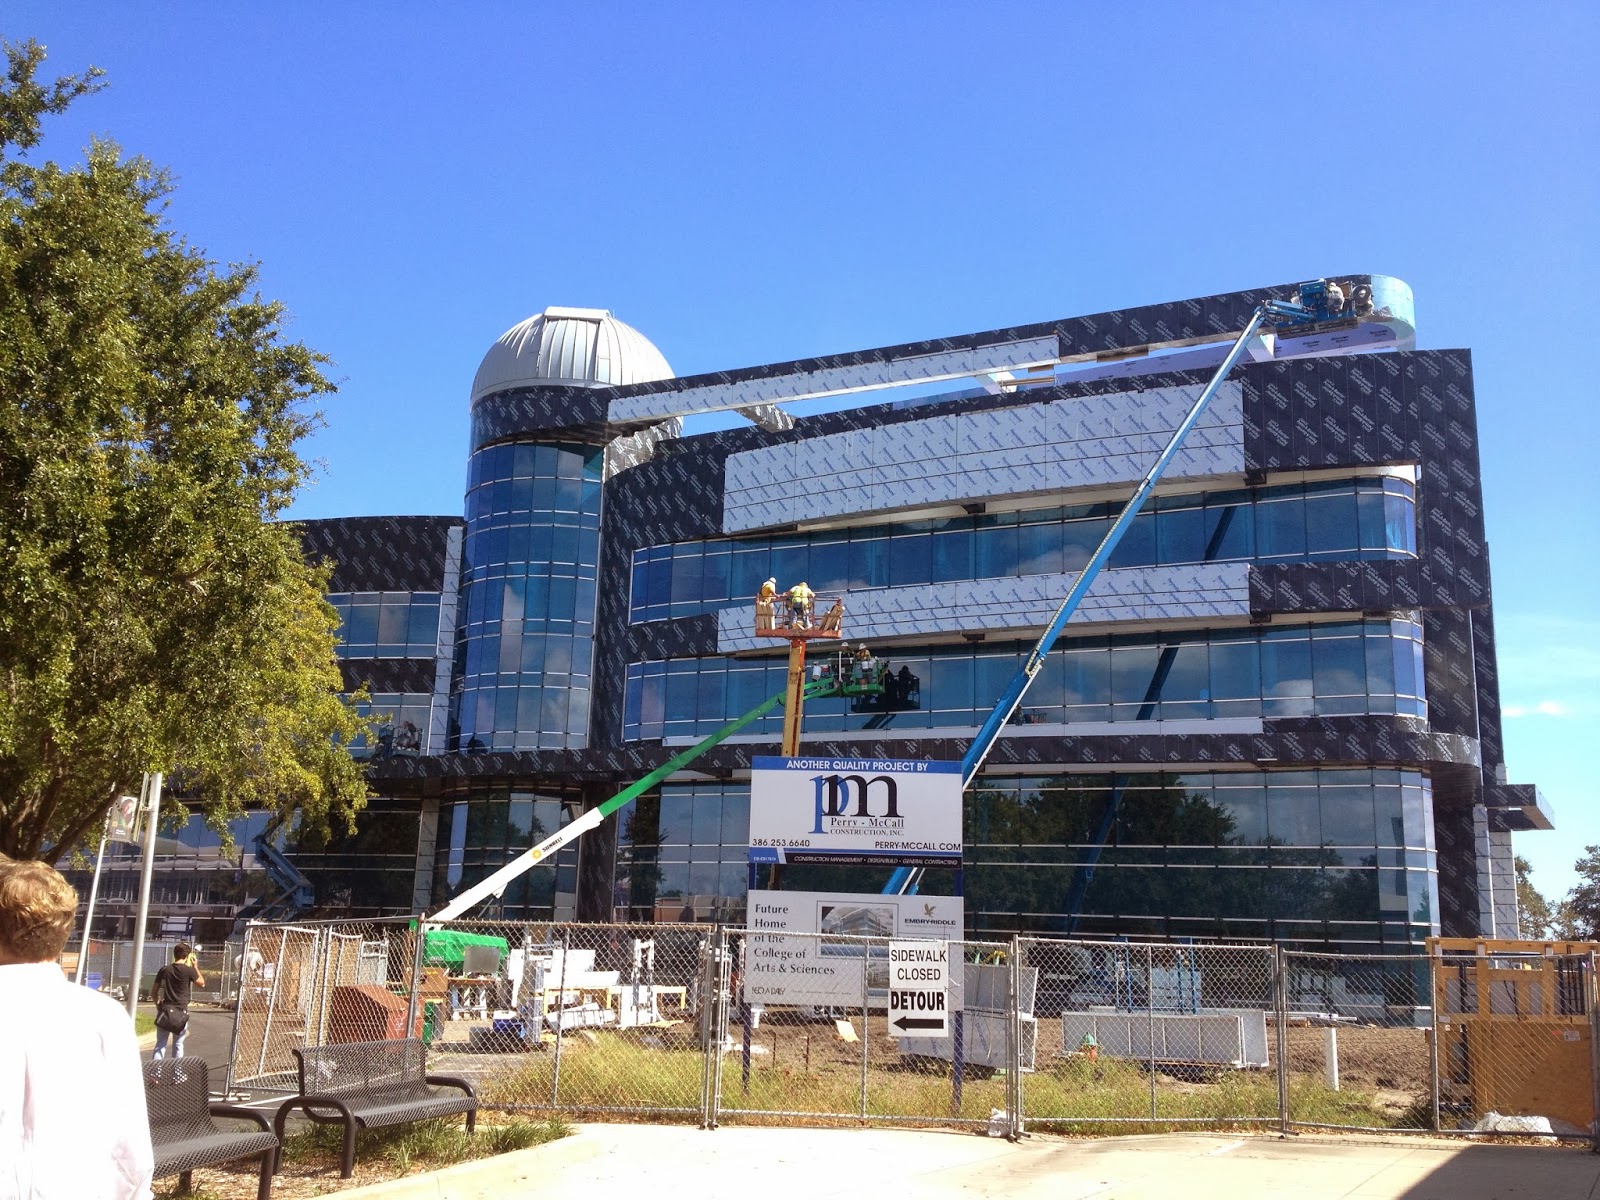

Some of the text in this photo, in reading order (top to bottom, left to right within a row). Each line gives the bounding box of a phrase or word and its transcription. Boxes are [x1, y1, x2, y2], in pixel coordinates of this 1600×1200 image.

[786, 760, 929, 772] ANOTHER QUALITY PROJECT BY
[831, 817, 858, 828] Perry
[869, 818, 905, 828] McCall
[755, 904, 789, 914] Future
[755, 919, 787, 928] Home
[754, 935, 785, 943] of the
[754, 947, 807, 960] College of
[890, 949, 947, 962] SIDEWALK
[753, 962, 835, 975] Arts & Sciences
[897, 968, 941, 981] CLOSED
[890, 991, 945, 1011] DETOUR
